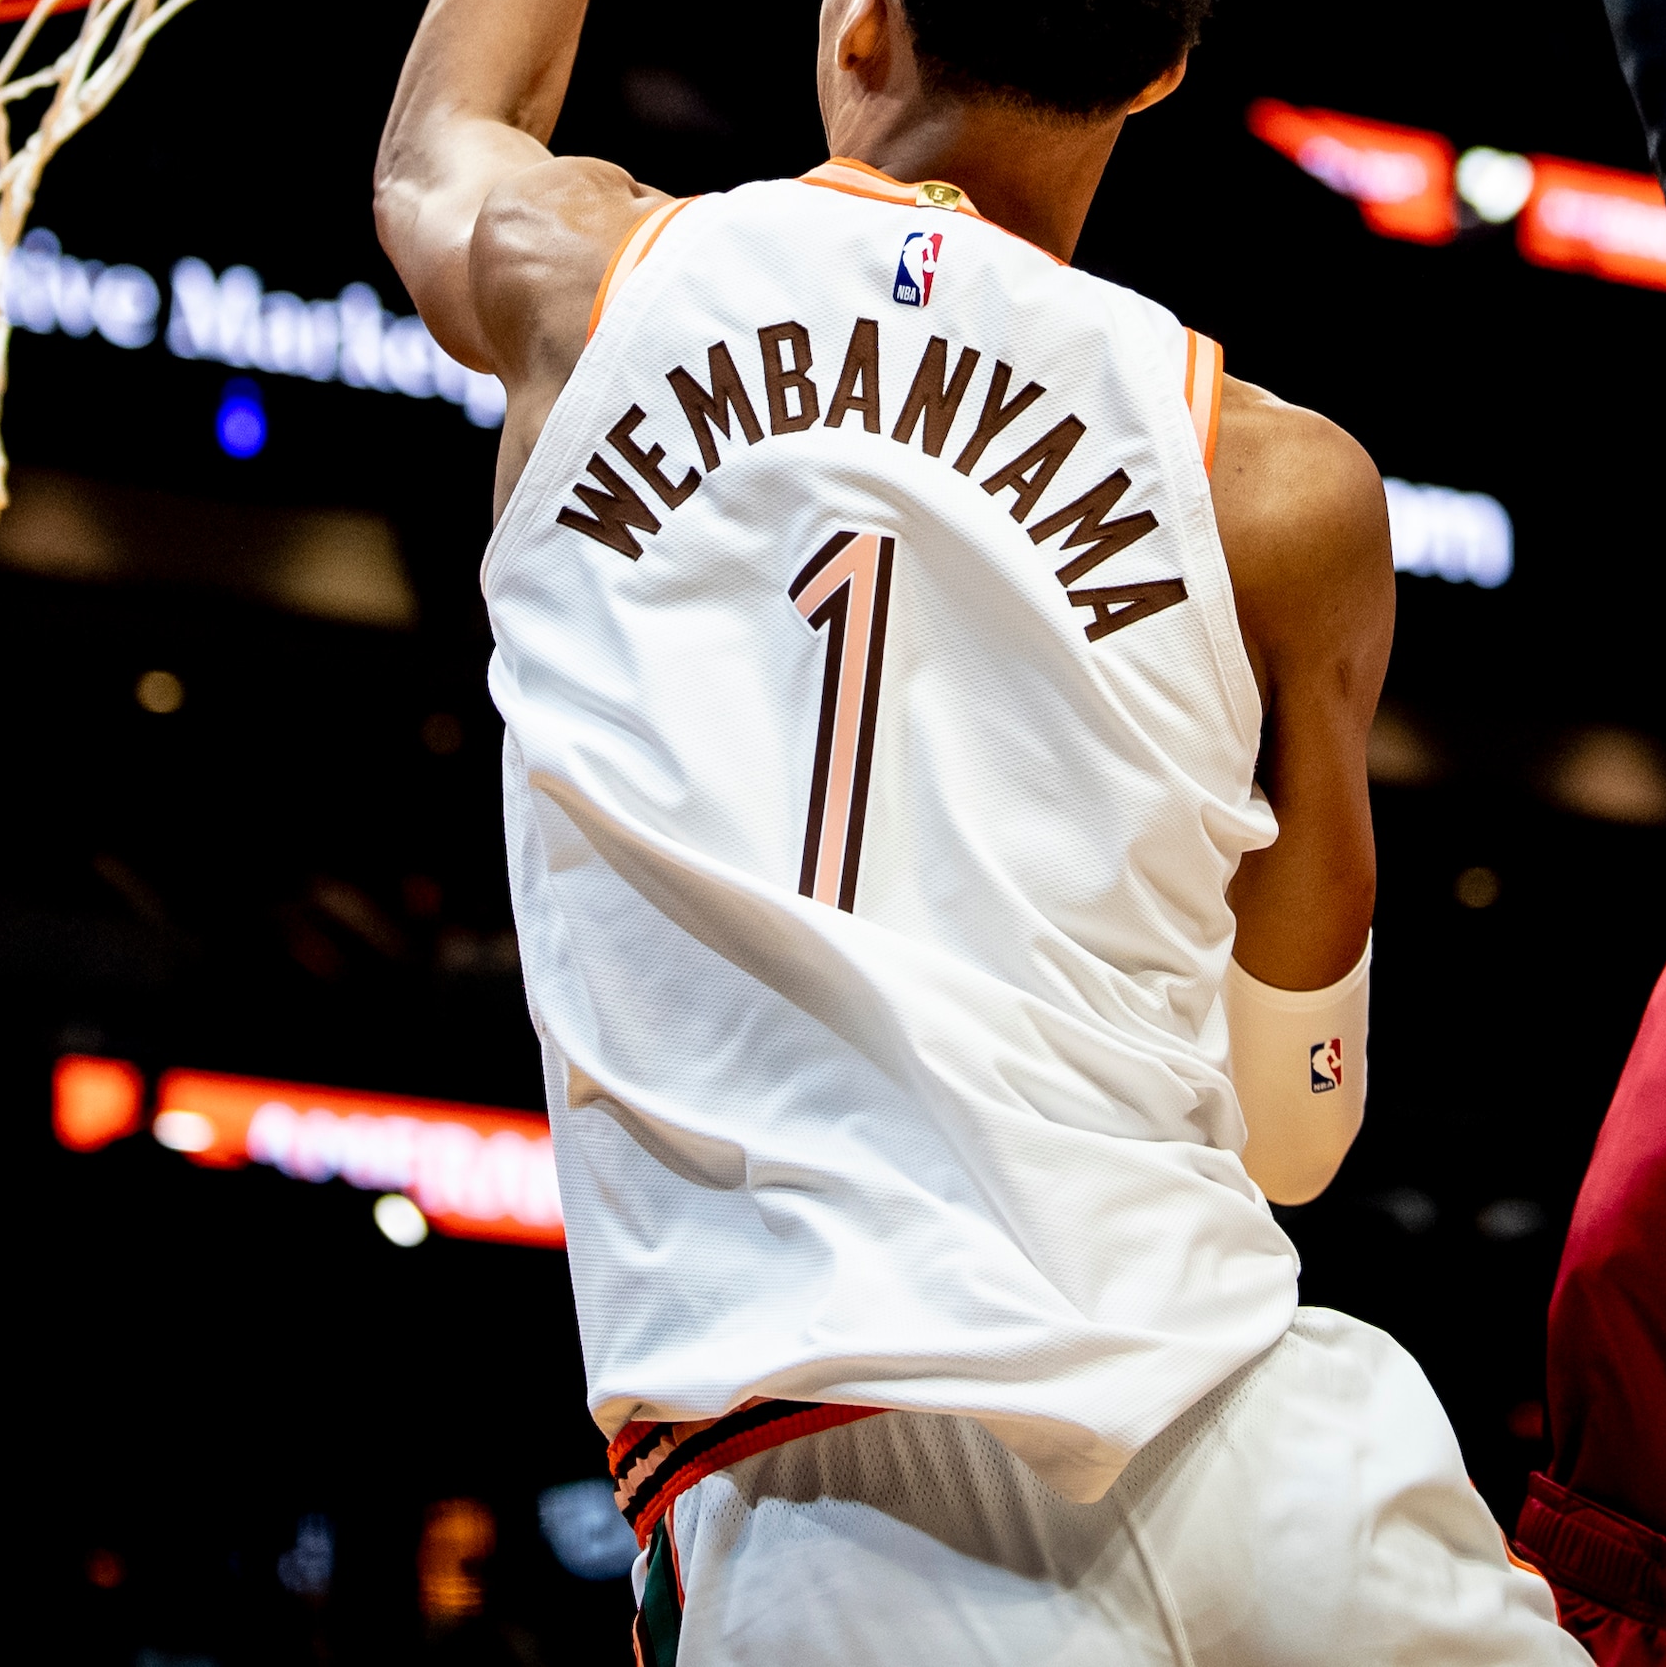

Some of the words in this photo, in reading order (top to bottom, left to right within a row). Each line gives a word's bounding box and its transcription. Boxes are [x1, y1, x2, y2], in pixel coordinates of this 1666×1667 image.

[896, 284, 917, 303] NBA
[556, 317, 1189, 643] WEMBANYAMA
[786, 529, 896, 914] 1
